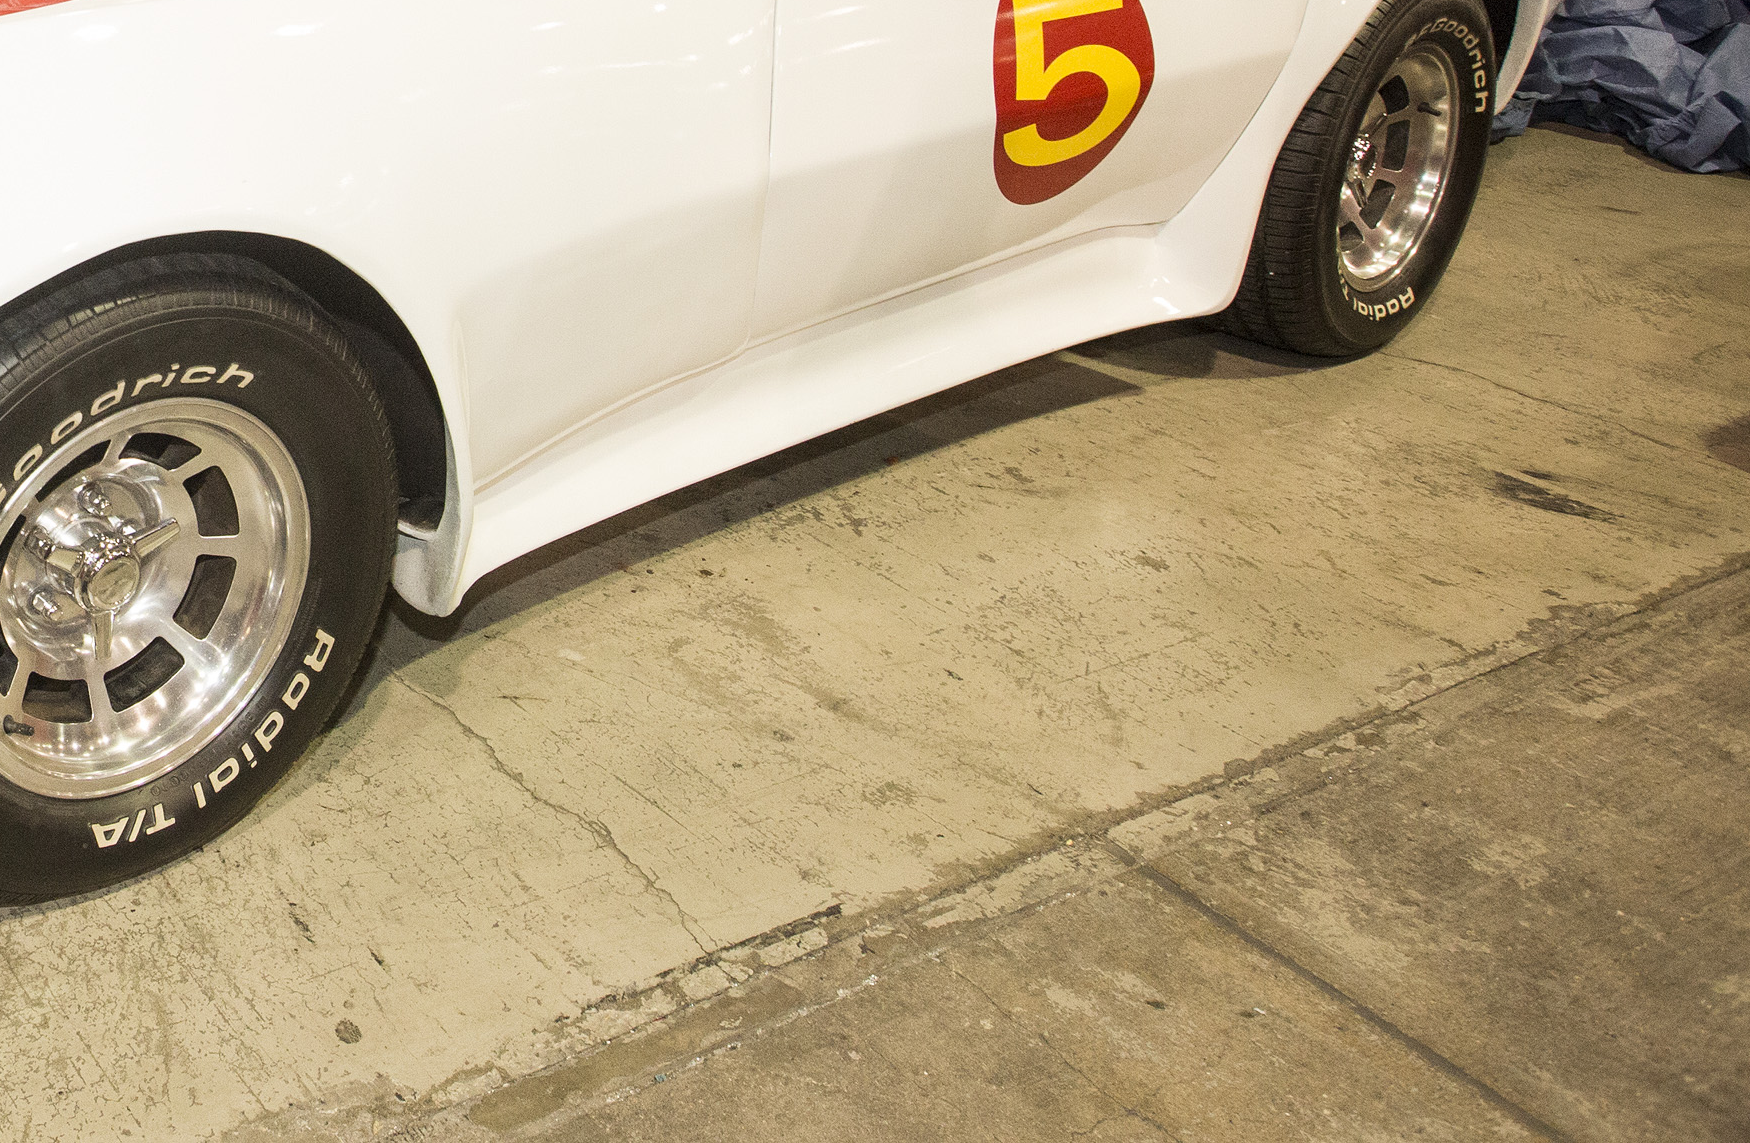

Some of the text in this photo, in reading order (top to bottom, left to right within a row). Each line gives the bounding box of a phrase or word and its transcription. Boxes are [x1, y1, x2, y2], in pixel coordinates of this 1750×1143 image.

[1352, 286, 1416, 322] Radial
[193, 628, 336, 810] Radial
[91, 803, 177, 849] T/A
